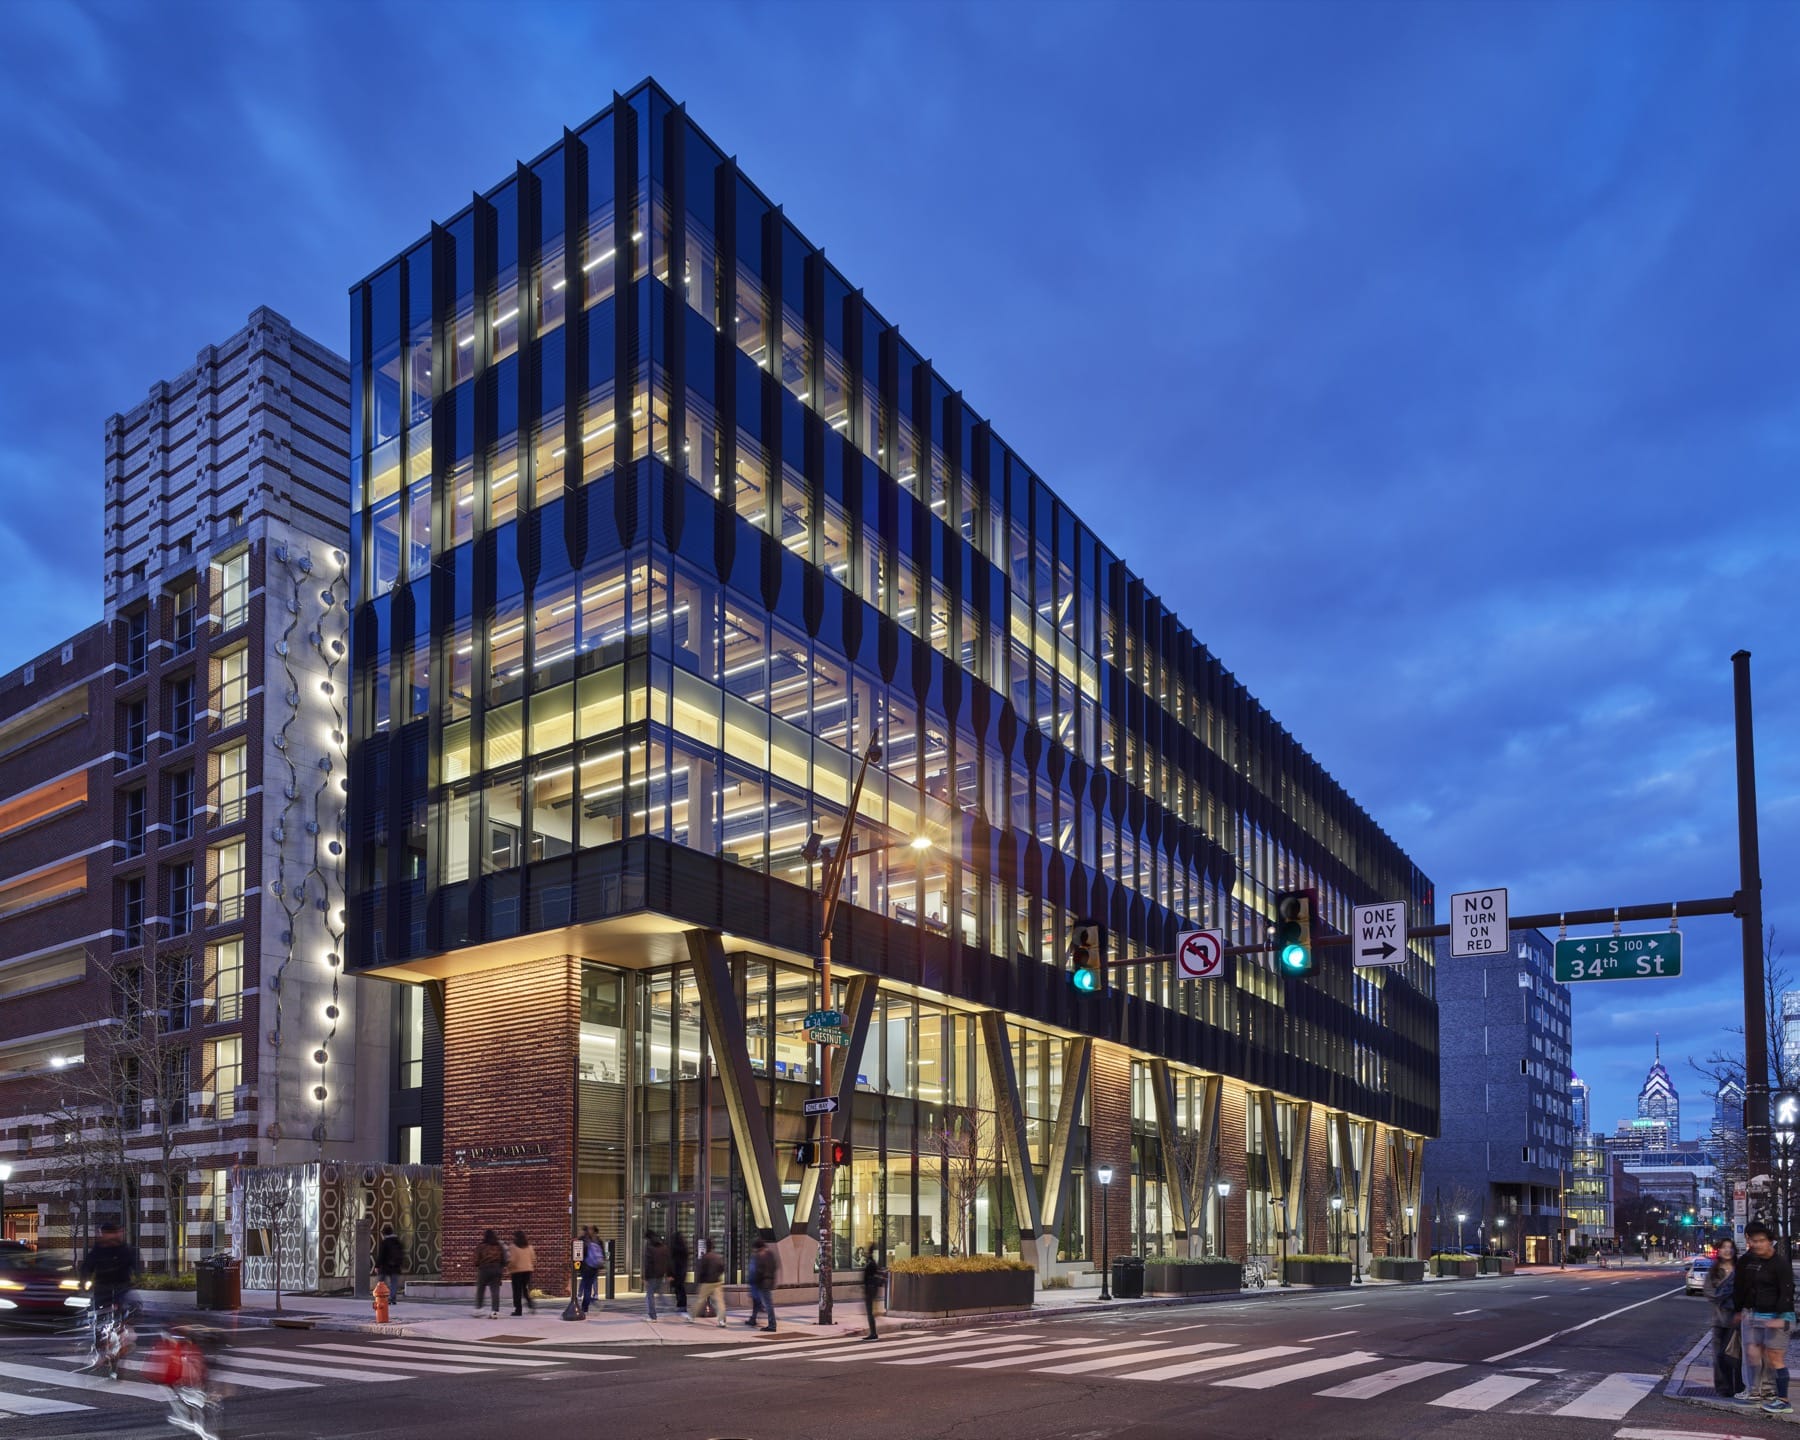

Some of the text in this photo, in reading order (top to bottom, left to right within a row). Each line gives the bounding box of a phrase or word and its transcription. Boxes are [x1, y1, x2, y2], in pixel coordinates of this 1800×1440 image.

[1465, 897, 1493, 912] NO
[1364, 908, 1395, 924] ONE
[1464, 912, 1496, 926] TURN
[1362, 924, 1397, 940] WAY
[1470, 926, 1489, 938] ON
[1467, 938, 1492, 951] RED
[1608, 940, 1619, 953] S
[1624, 940, 1643, 951] 100
[1570, 955, 1665, 979] 34th St
[811, 1031, 841, 1044] CHESTNUT
